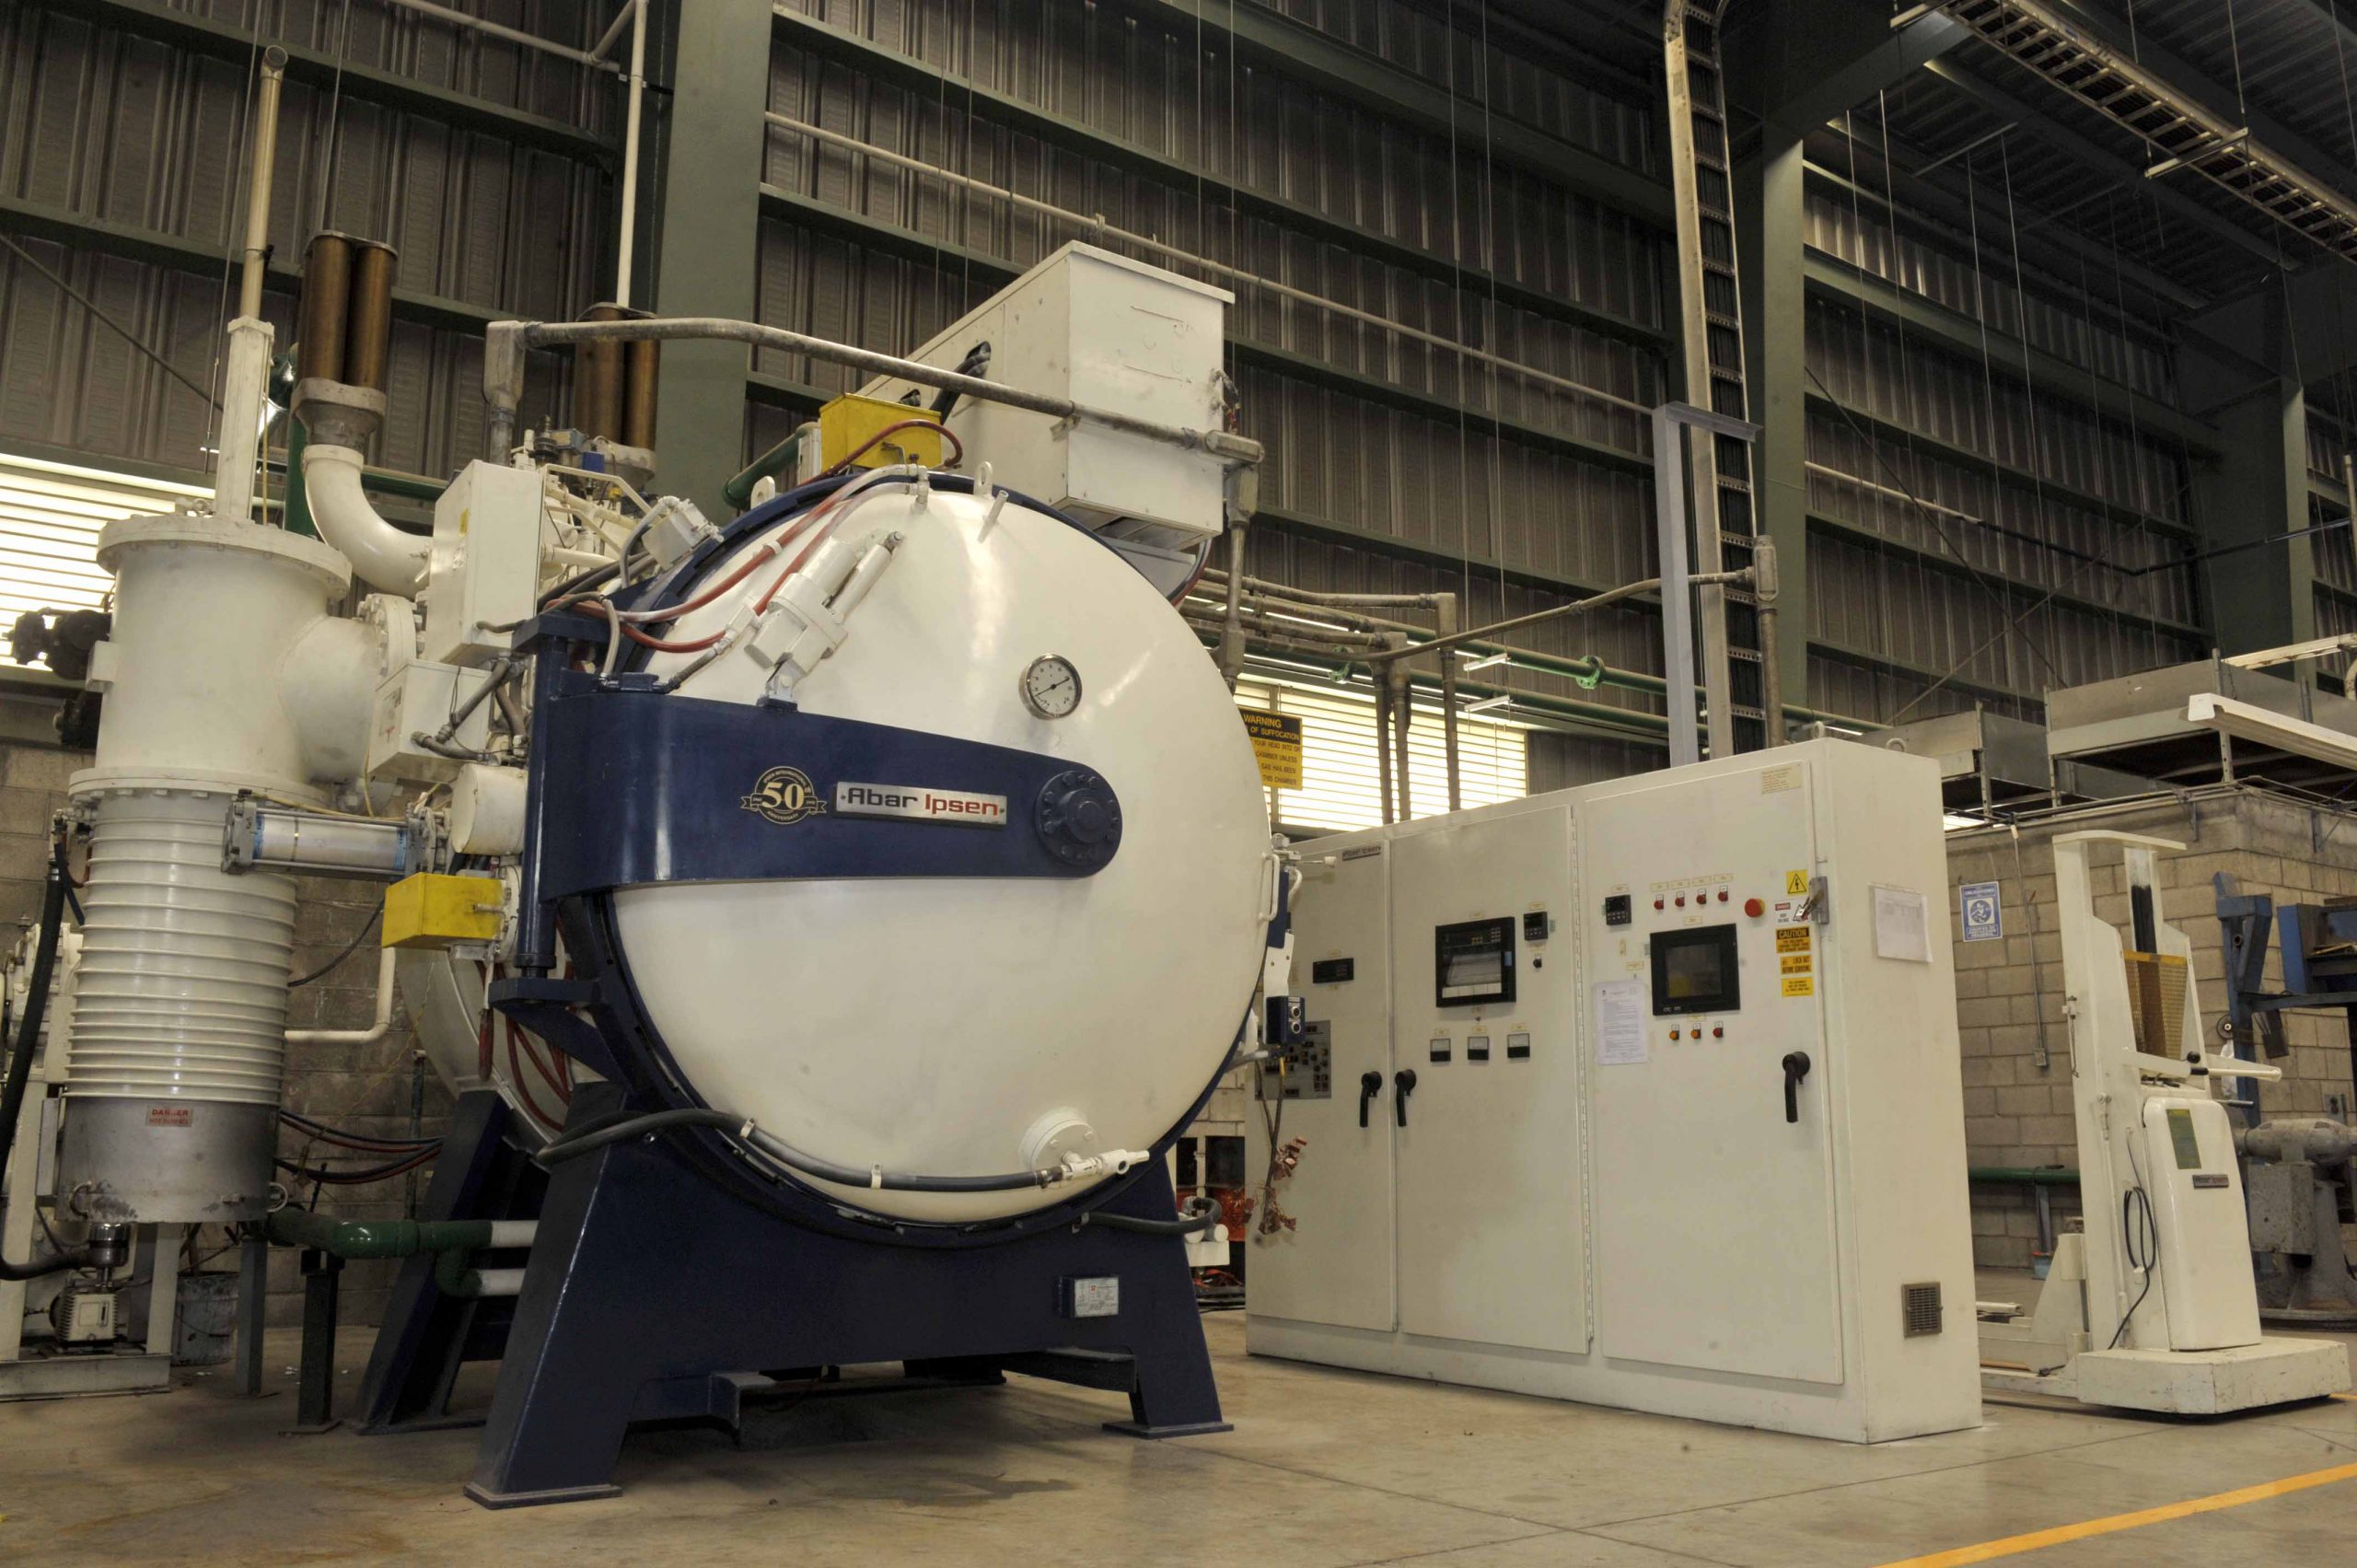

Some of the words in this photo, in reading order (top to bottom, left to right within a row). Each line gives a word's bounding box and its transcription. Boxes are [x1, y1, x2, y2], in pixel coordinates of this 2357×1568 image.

[1243, 714, 1282, 728] WARNING
[1261, 728, 1300, 740] SUFFOCATION
[761, 782, 805, 810] 50
[847, 787, 918, 808] Abar
[924, 794, 998, 817] Ipsen
[1779, 927, 1807, 938] CAUTION
